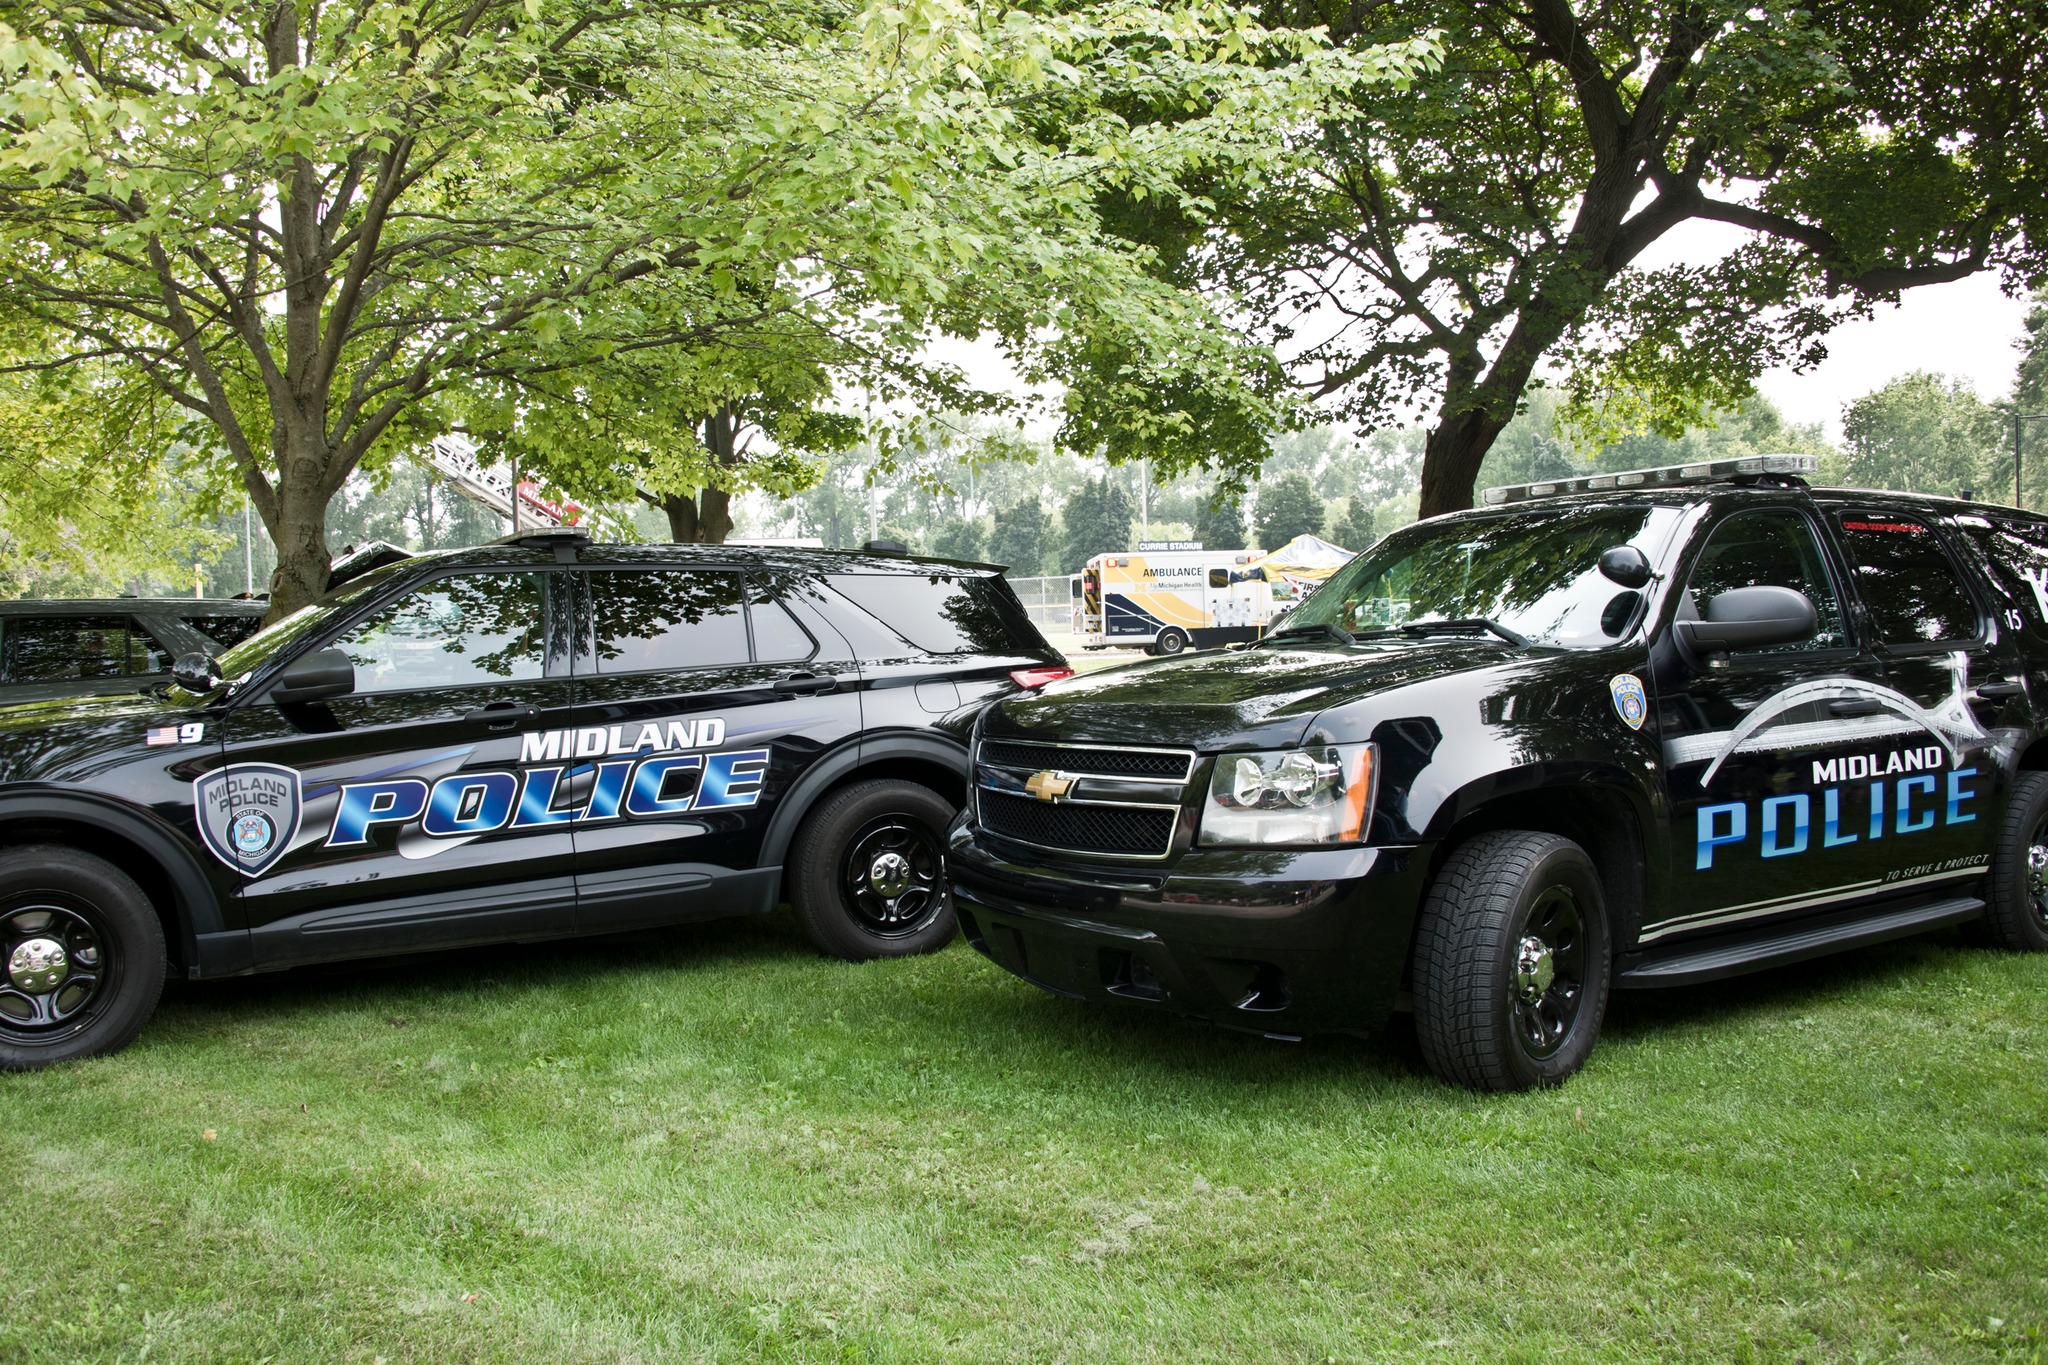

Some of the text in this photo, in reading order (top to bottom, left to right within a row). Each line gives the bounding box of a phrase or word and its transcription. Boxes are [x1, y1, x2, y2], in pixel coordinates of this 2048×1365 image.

[1139, 542, 1203, 551] CURRIE STADIUM
[1143, 567, 1203, 578] AMBULANCE
[2003, 608, 2023, 630] 15
[1615, 685, 1640, 697] POLICE
[181, 723, 204, 743] 9
[520, 718, 725, 762] MIDLAND
[1812, 746, 1942, 784] MIDLAND
[209, 777, 287, 804] MIDLAND
[323, 748, 770, 848] POLICE
[219, 792, 279, 812] POLICE
[235, 809, 253, 820] STATE
[1696, 767, 1977, 870] POLICE
[238, 847, 268, 858] MICHIGAN
[1886, 853, 1990, 881] TO SERVE & PROTECT
